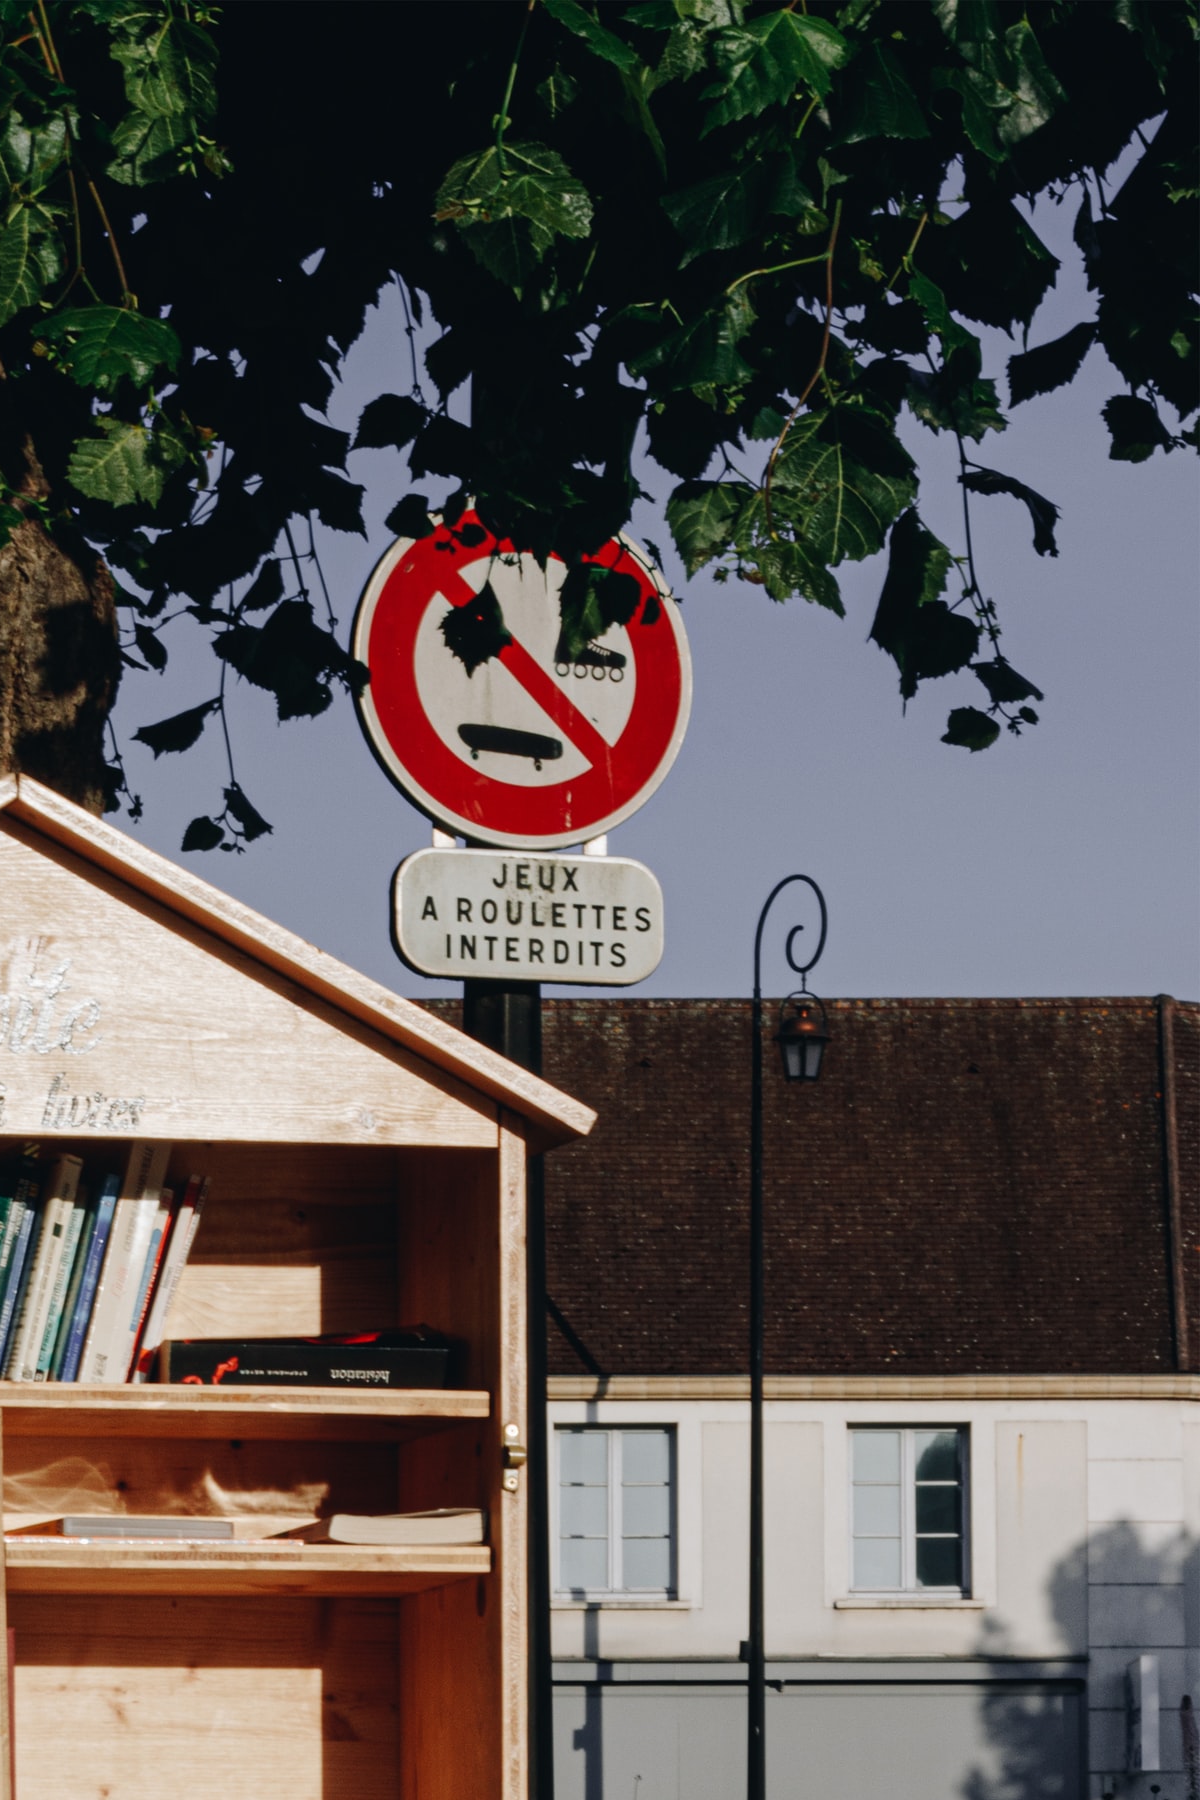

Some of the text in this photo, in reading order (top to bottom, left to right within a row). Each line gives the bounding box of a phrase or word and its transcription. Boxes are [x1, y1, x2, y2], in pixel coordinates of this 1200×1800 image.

[492, 864, 579, 892] JEUX
[421, 896, 652, 932] A ROULETTES
[446, 933, 628, 968] INTERDITS
[331, 1368, 390, 1385] hésitation
